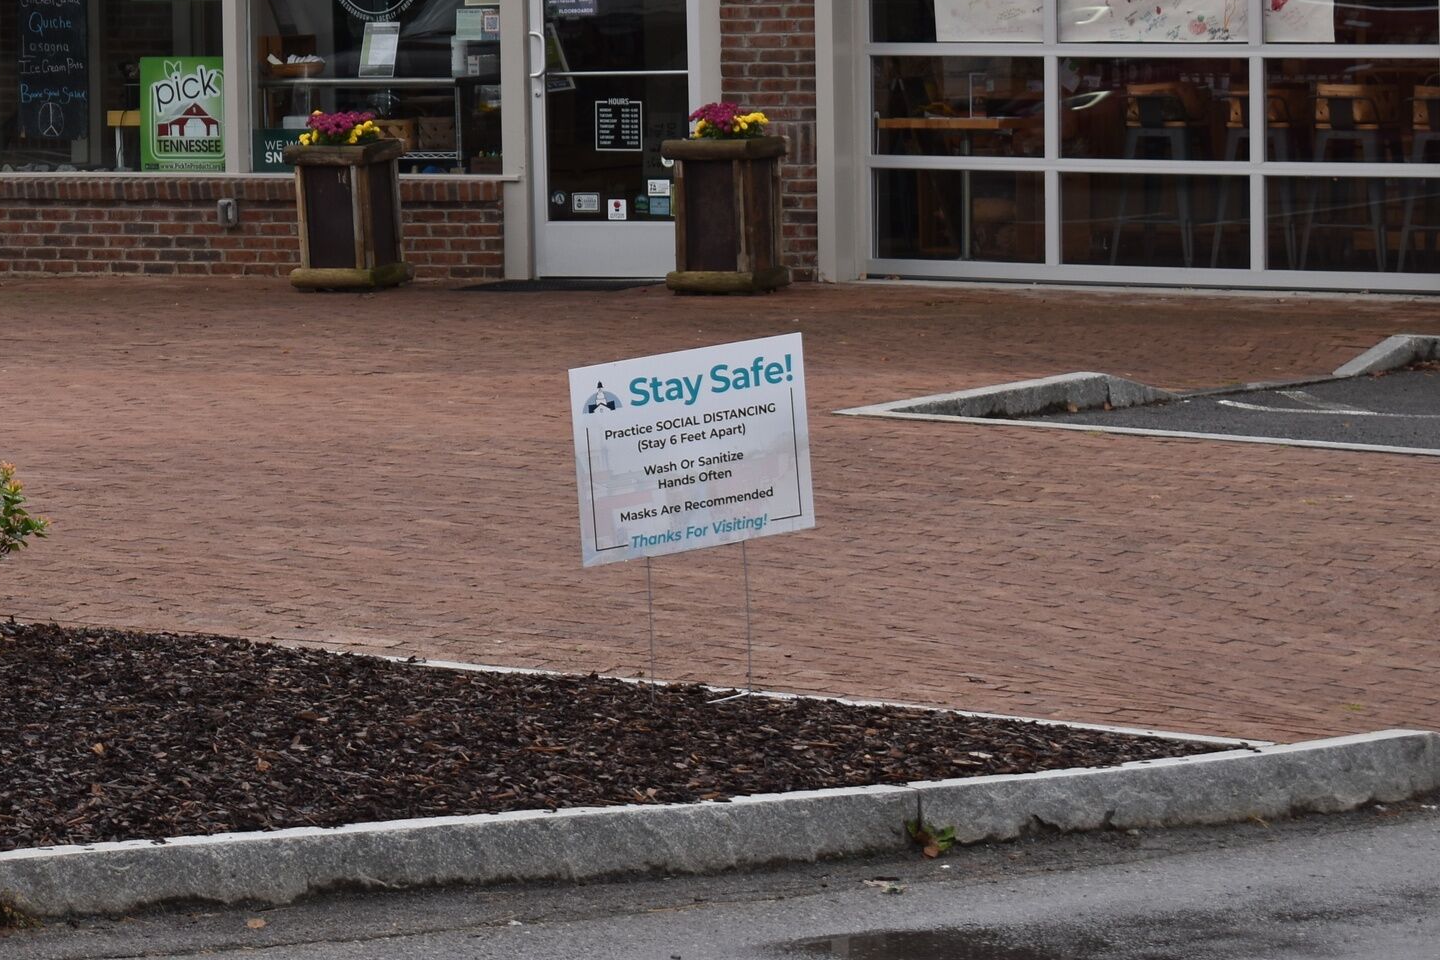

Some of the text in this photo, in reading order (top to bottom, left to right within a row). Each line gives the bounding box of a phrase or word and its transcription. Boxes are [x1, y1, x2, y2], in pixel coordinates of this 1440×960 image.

[29, 11, 72, 37] Quiche
[22, 34, 70, 58] Lasagna
[18, 59, 40, 74] Ice
[41, 58, 66, 73] Cream
[154, 67, 217, 113] pick
[608, 97, 630, 106] HOURS
[157, 139, 221, 153] TENNESSEE
[264, 139, 283, 151] WE
[264, 151, 284, 164] SN
[628, 353, 793, 407] Stay Safe!
[604, 402, 776, 440] Practice SOCIAL DISTANCING
[637, 422, 746, 453] (Stay 6 Feet Apart)
[643, 450, 744, 476] Wash Or Sanitize
[657, 467, 733, 490] Hands Often
[620, 486, 774, 522] Masks Are Recommended
[631, 512, 768, 549] Thanks For Visiting!
